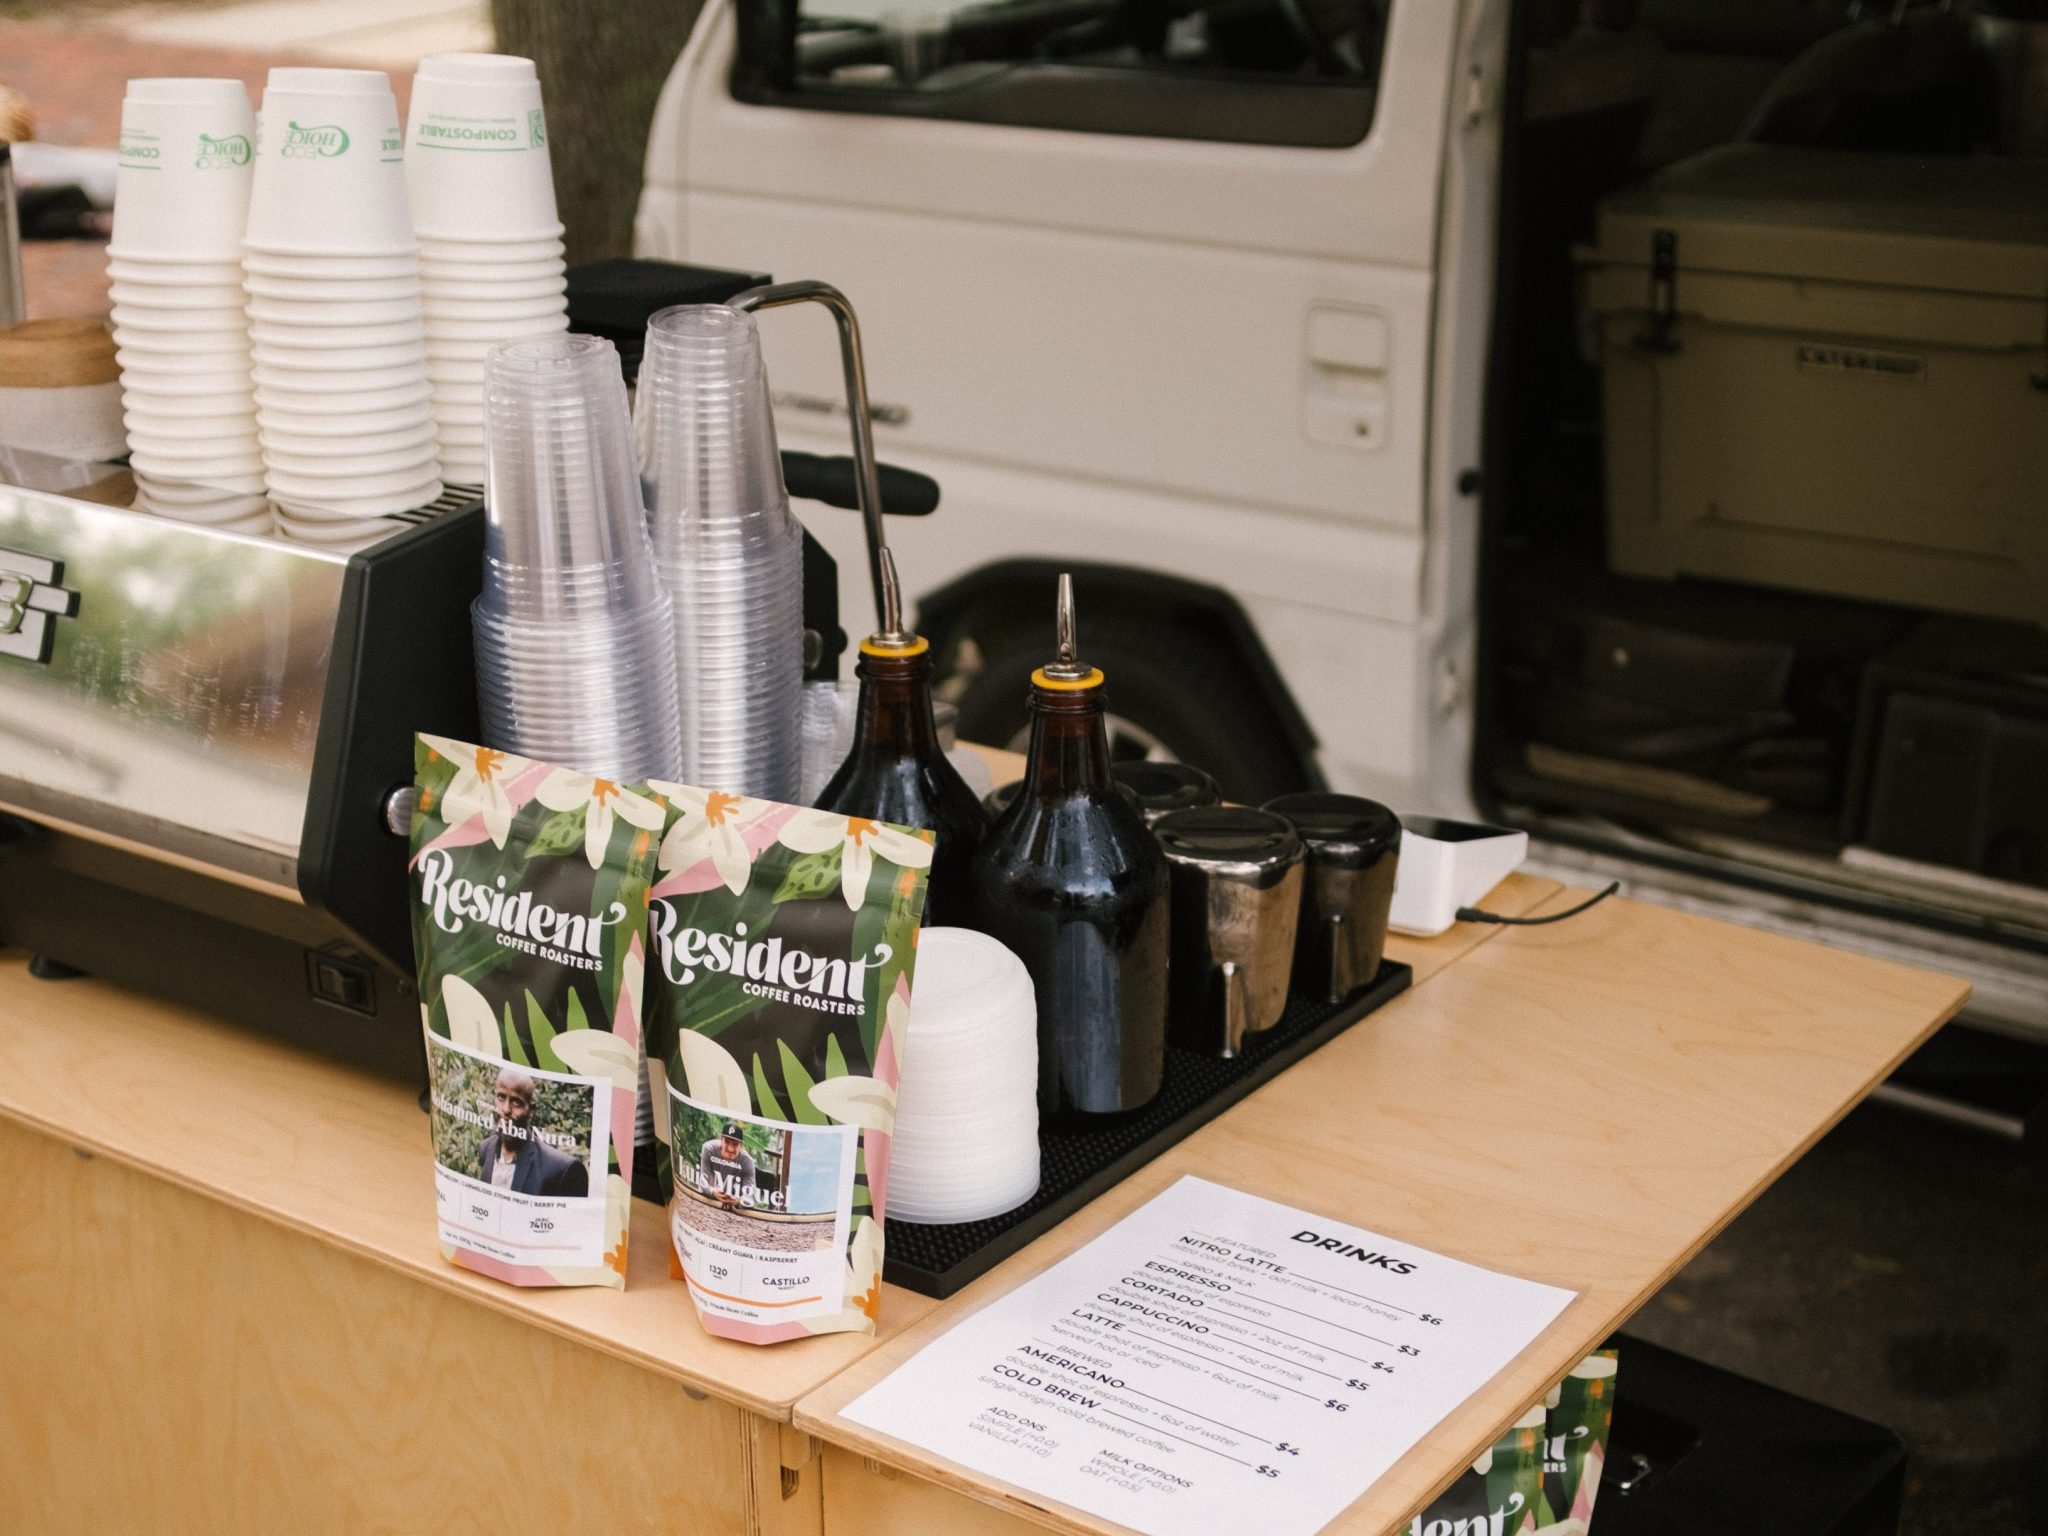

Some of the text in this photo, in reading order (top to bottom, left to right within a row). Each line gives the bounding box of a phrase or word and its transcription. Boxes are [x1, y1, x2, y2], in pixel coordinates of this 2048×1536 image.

[288, 120, 350, 157] CHOICE
[420, 124, 516, 140] COMPOSTABLE
[418, 847, 627, 957] Resident
[496, 933, 603, 971] COFFEE ROASTERS
[649, 898, 893, 1002] Resident
[743, 981, 866, 1016] COFFEE ROASTERS
[497, 1117, 527, 1140] Aba
[531, 1125, 577, 1147] Nura
[711, 1155, 742, 1170] COLOMBIA
[678, 1154, 791, 1207] Luis Miguel
[471, 1204, 489, 1217] 2100
[529, 1221, 554, 1230] 74110
[708, 1242, 731, 1256] CREAMY
[733, 1250, 754, 1260] GUAVA
[759, 1256, 798, 1264] RASPBERRY
[1179, 1236, 1287, 1274] NITRO LATTE
[1215, 1235, 1277, 1259] FEATURED
[1291, 1230, 1418, 1275] DRINKS
[709, 1264, 728, 1277] 1320
[762, 1276, 810, 1286] CASTILLO
[1145, 1261, 1231, 1292] ESPRESSO
[1121, 1276, 1204, 1307] CORTADO
[1132, 1269, 1175, 1285] double
[1177, 1281, 1204, 1295] shot
[1218, 1296, 1272, 1318] espresso
[1229, 1260, 1260, 1274] brew
[1292, 1281, 1319, 1294] milk
[1330, 1293, 1361, 1308] local
[1362, 1304, 1401, 1322] honey
[1072, 1308, 1126, 1331] LATTE
[1097, 1293, 1210, 1334] CAPPUCCINO
[1109, 1285, 1151, 1301] double
[1151, 1299, 1180, 1313] shot
[1195, 1314, 1248, 1335] espresso
[1259, 1335, 1283, 1347] 2oz
[1299, 1349, 1328, 1364] milk
[1419, 1313, 1443, 1326] $6
[1084, 1302, 1126, 1318] double
[1128, 1315, 1156, 1329] shot
[1171, 1331, 1225, 1353] espresso
[1237, 1354, 1260, 1366] 4oz
[1277, 1367, 1307, 1382] milk
[1097, 1341, 1117, 1353] hot
[1133, 1356, 1161, 1369] iced
[1397, 1344, 1421, 1357] $3
[1018, 1345, 1125, 1388] AMERICANO
[1056, 1345, 1112, 1369] BREWED
[1059, 1318, 1100, 1335] double
[1103, 1332, 1131, 1346] shot
[1147, 1349, 1201, 1372] espresso
[1212, 1373, 1236, 1385] 6oz
[1250, 1387, 1281, 1402] milk
[1371, 1361, 1395, 1374] $4
[993, 1364, 1101, 1409] COLD BREW
[1346, 1378, 1370, 1392] $5
[1006, 1354, 1049, 1375] double
[1050, 1372, 1079, 1386] shot
[1094, 1390, 1149, 1413] espresso
[1161, 1414, 1185, 1427] 6oz
[1201, 1430, 1240, 1448] water
[1324, 1399, 1350, 1412] $6
[977, 1413, 1025, 1435] SIMPLE
[986, 1406, 1048, 1432] ADD ONS
[1057, 1404, 1086, 1420] cold
[1086, 1415, 1135, 1439] brewed
[1135, 1434, 1176, 1454] coffee
[968, 1421, 1020, 1446] VANILLA
[1275, 1442, 1300, 1456] $4
[1080, 1465, 1109, 1478] OAT
[1090, 1457, 1140, 1482] WHOLE
[1099, 1449, 1194, 1489] MILK OPTIONS
[1255, 1464, 1281, 1478] $5
